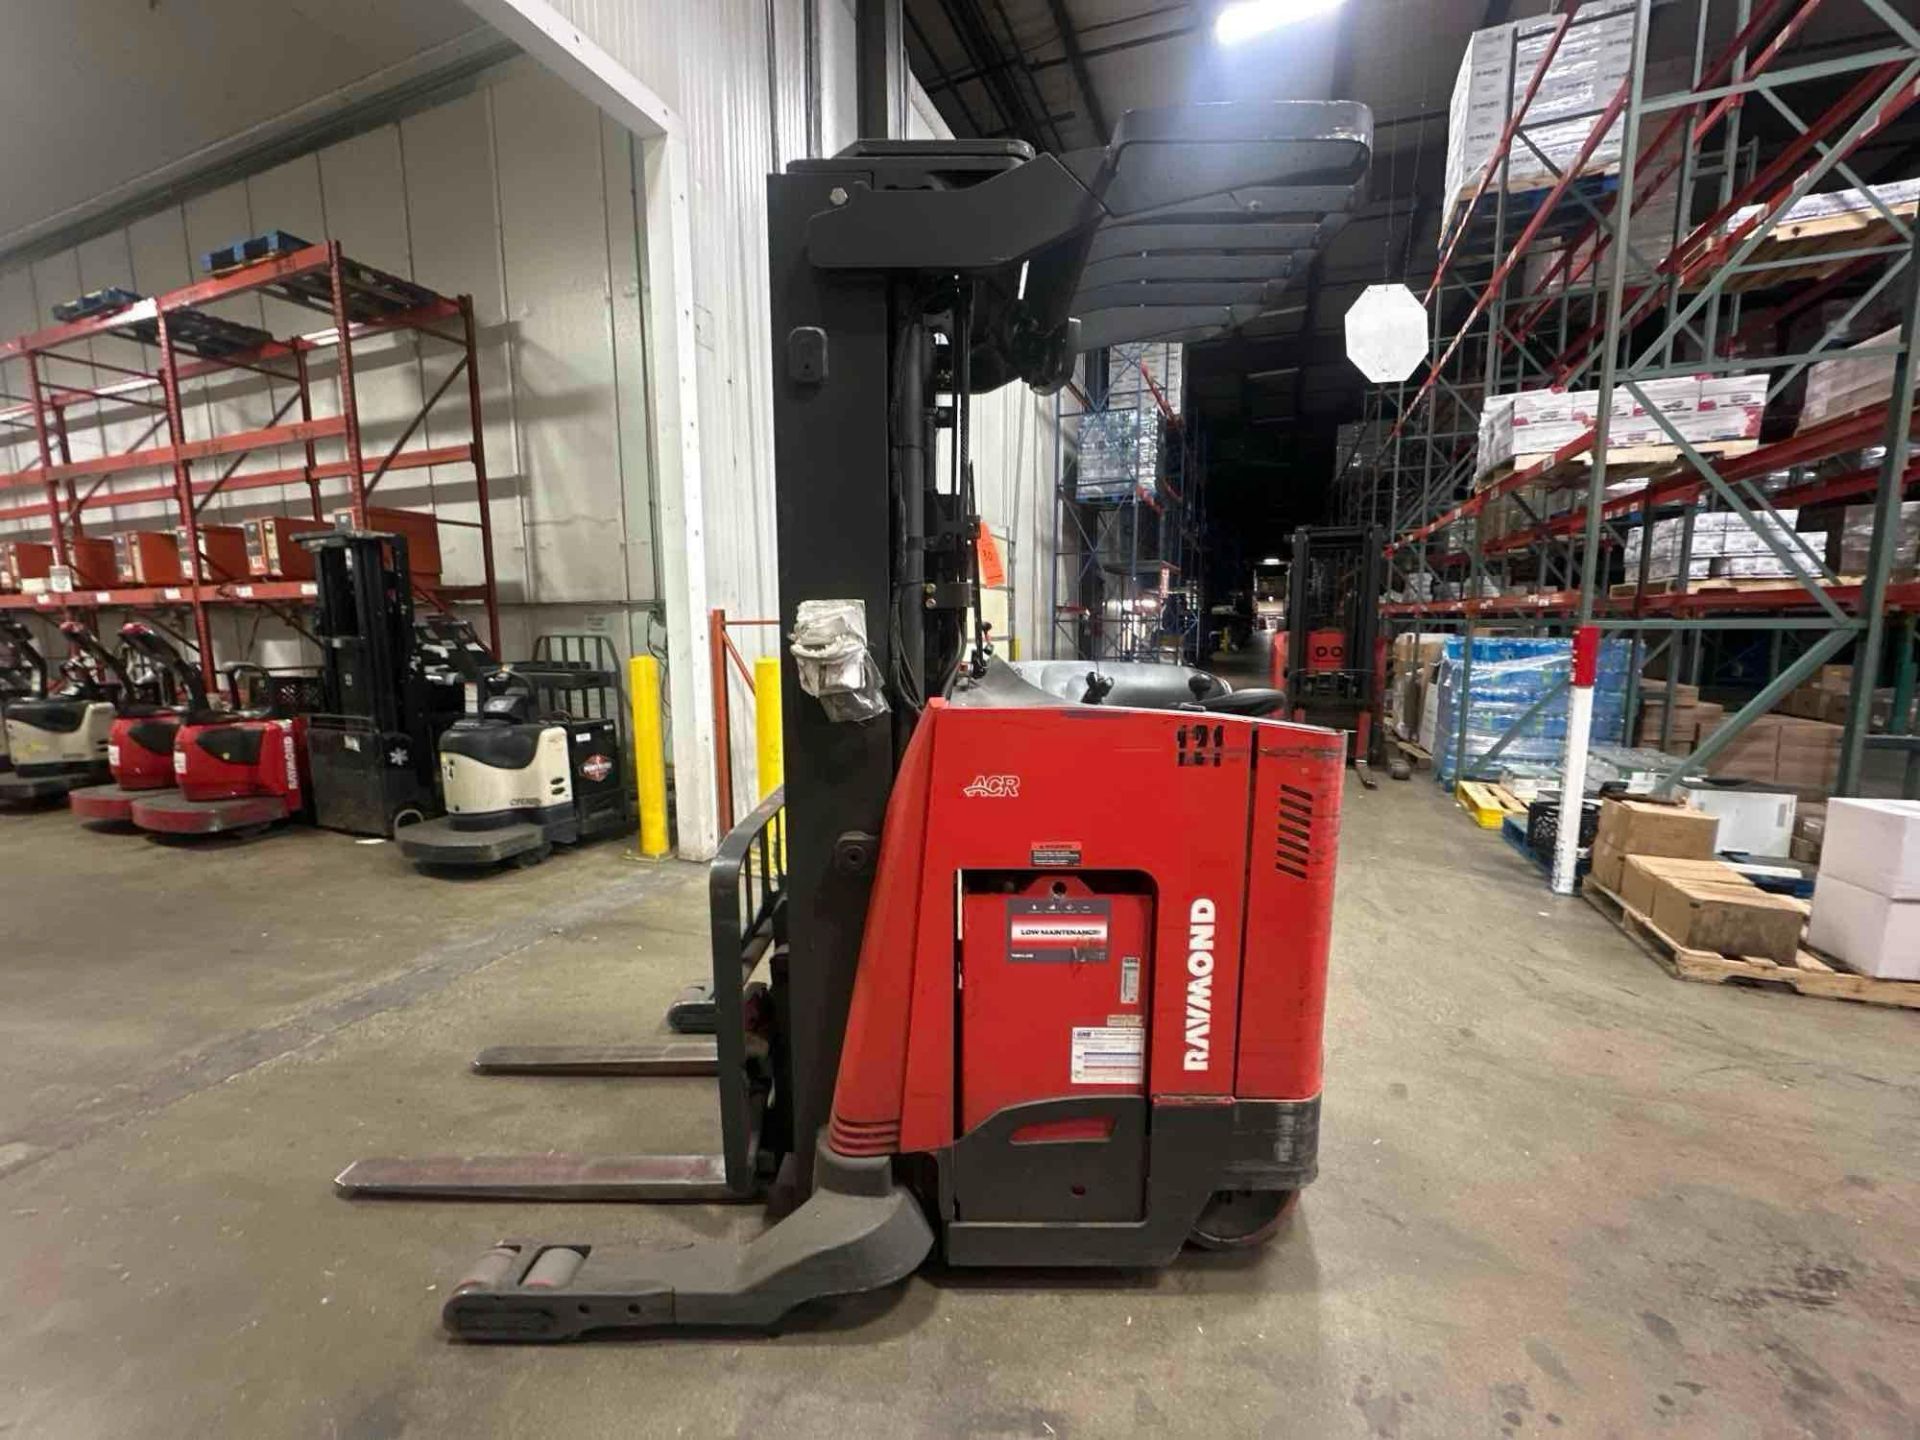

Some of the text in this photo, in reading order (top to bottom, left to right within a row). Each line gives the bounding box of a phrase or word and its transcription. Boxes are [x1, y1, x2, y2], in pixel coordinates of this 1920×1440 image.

[963, 774, 1020, 798] ACR
[1020, 928, 1039, 936] LOW
[1183, 897, 1217, 1072] RAYMOND
